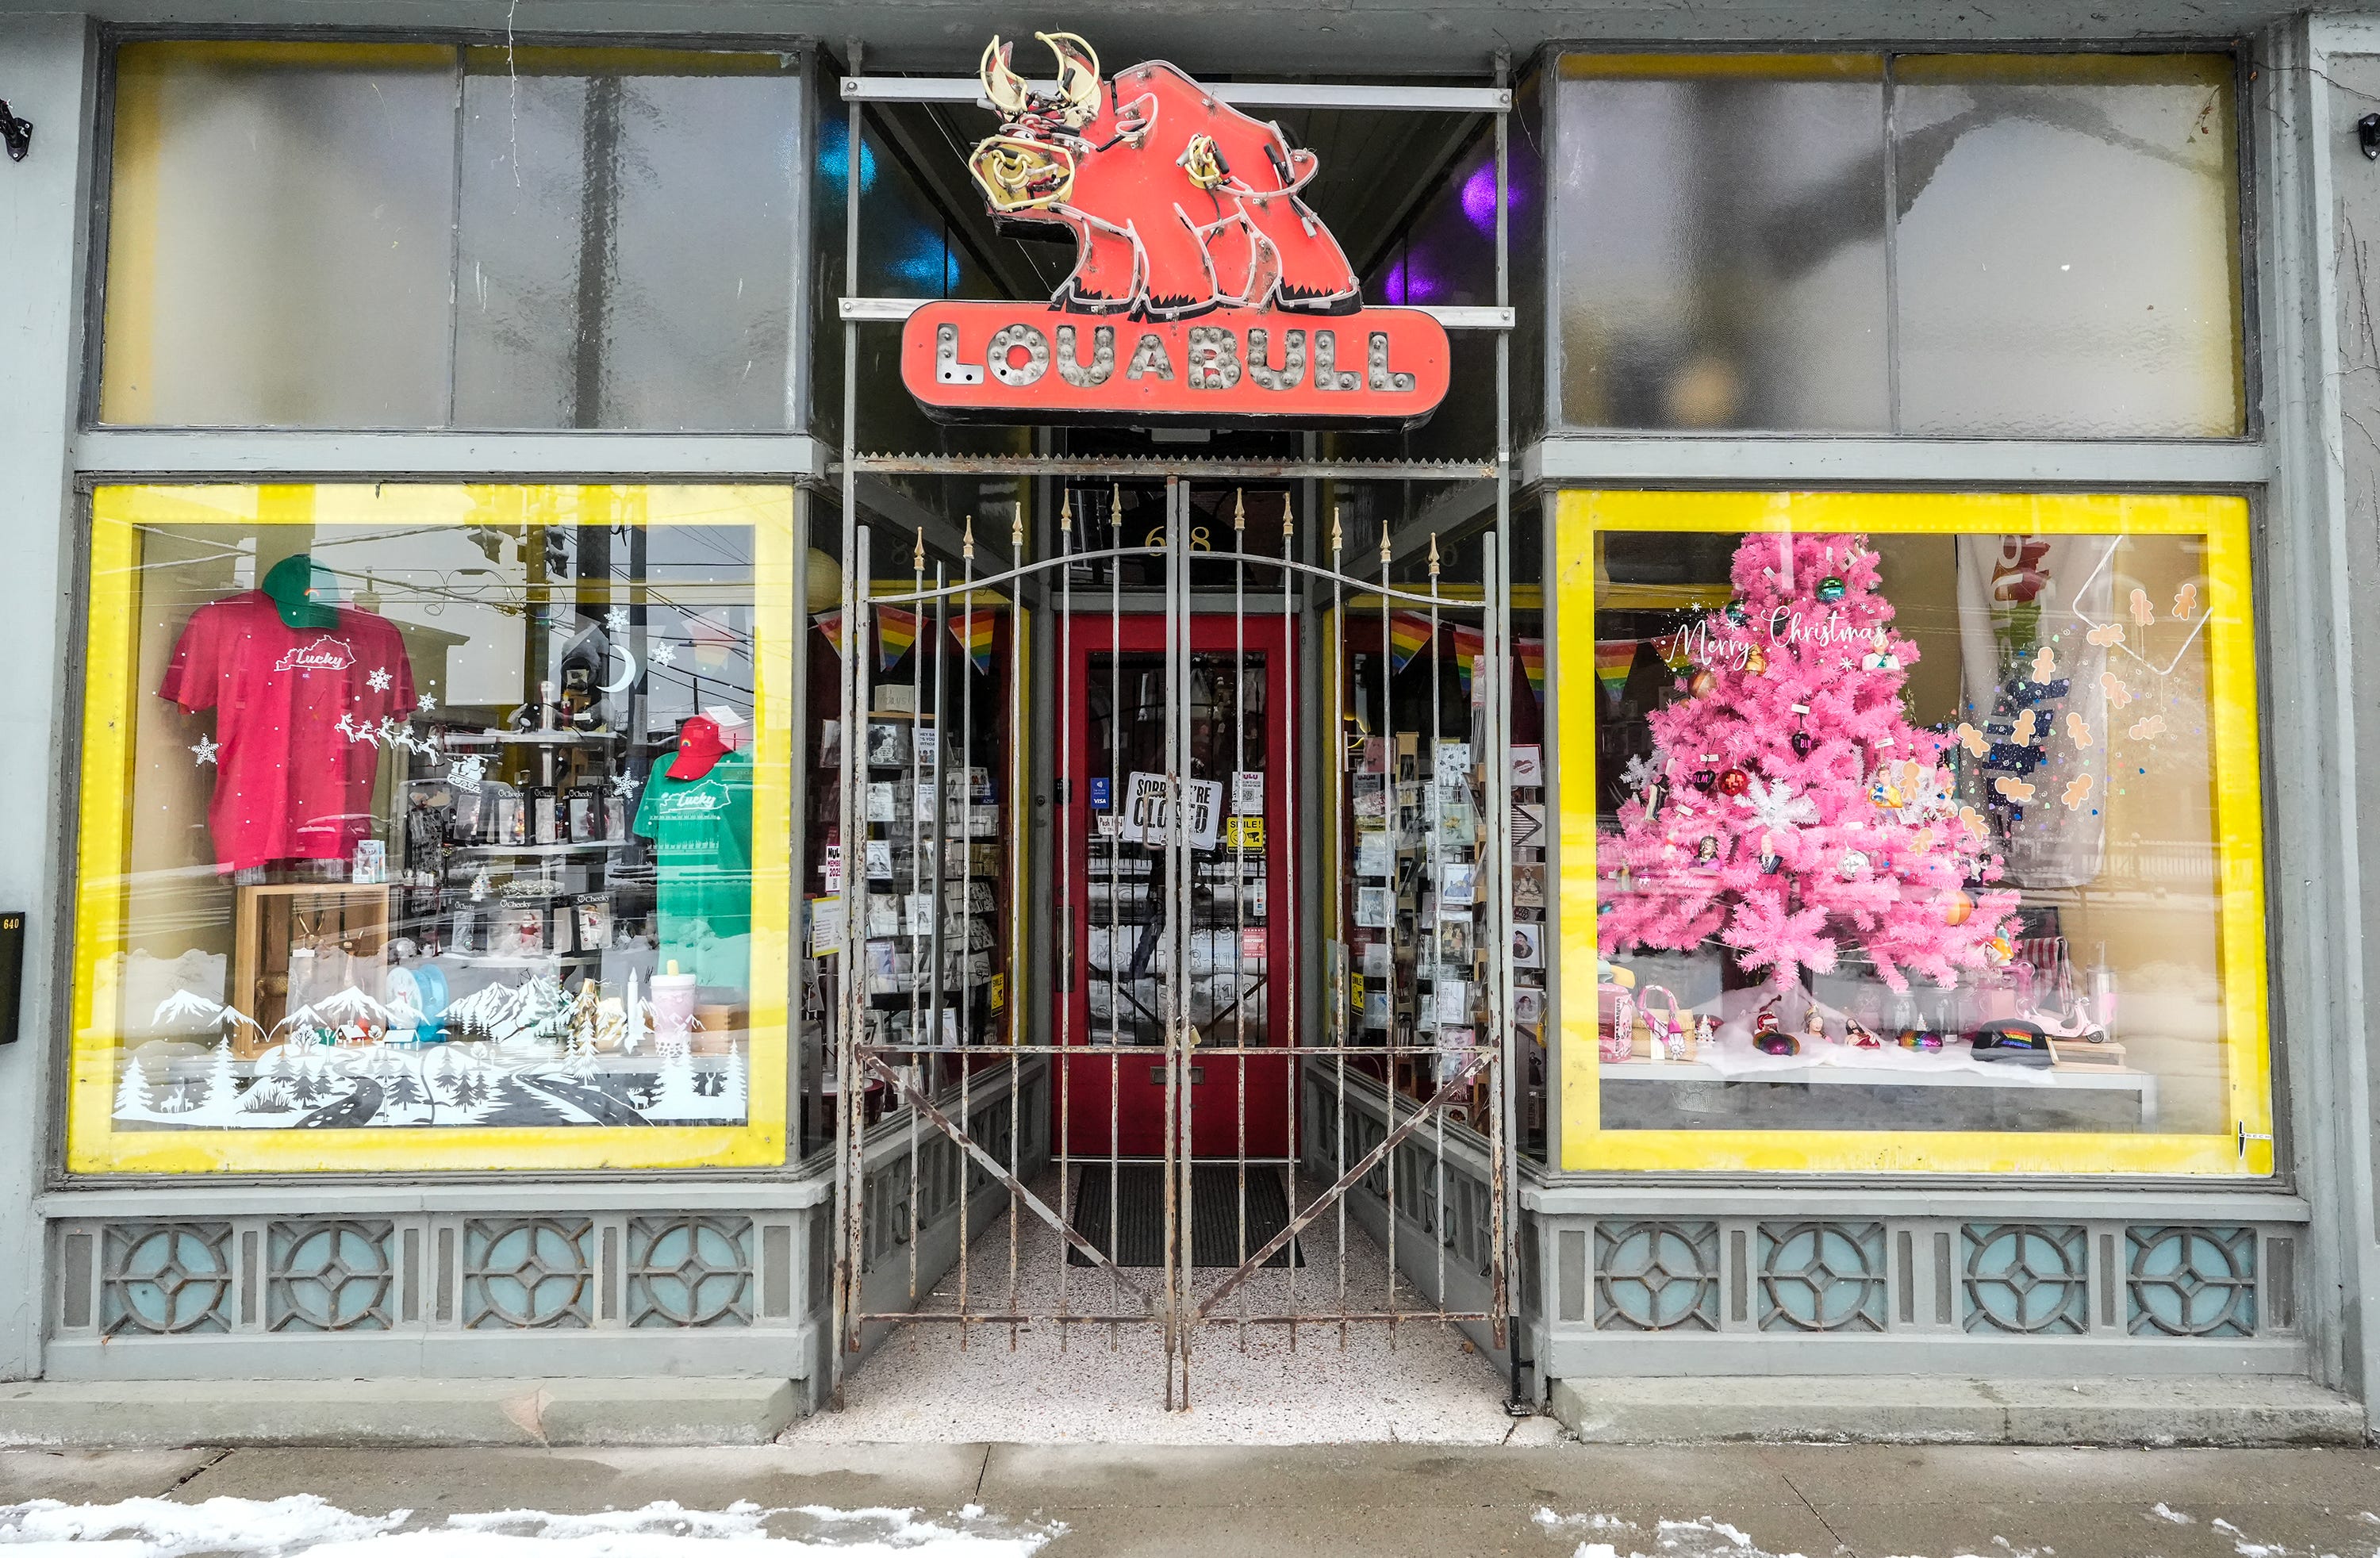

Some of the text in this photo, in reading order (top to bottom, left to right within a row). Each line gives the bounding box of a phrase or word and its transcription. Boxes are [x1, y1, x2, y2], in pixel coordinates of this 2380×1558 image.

[936, 323, 1417, 392] LOU A BULL
[1145, 526, 1211, 557] 68
[1666, 605, 1885, 671] Merry Christmas
[296, 650, 344, 669] Lucky
[1692, 774, 1708, 783] BLM
[1136, 778, 1173, 799] SORR
[677, 792, 716, 808] Lucky
[1133, 796, 1209, 834] CLOSD
[827, 847, 840, 859] NUL
[829, 868, 840, 877] 202
[507, 900, 532, 908] Cheeky
[3, 918, 20, 930] 640
